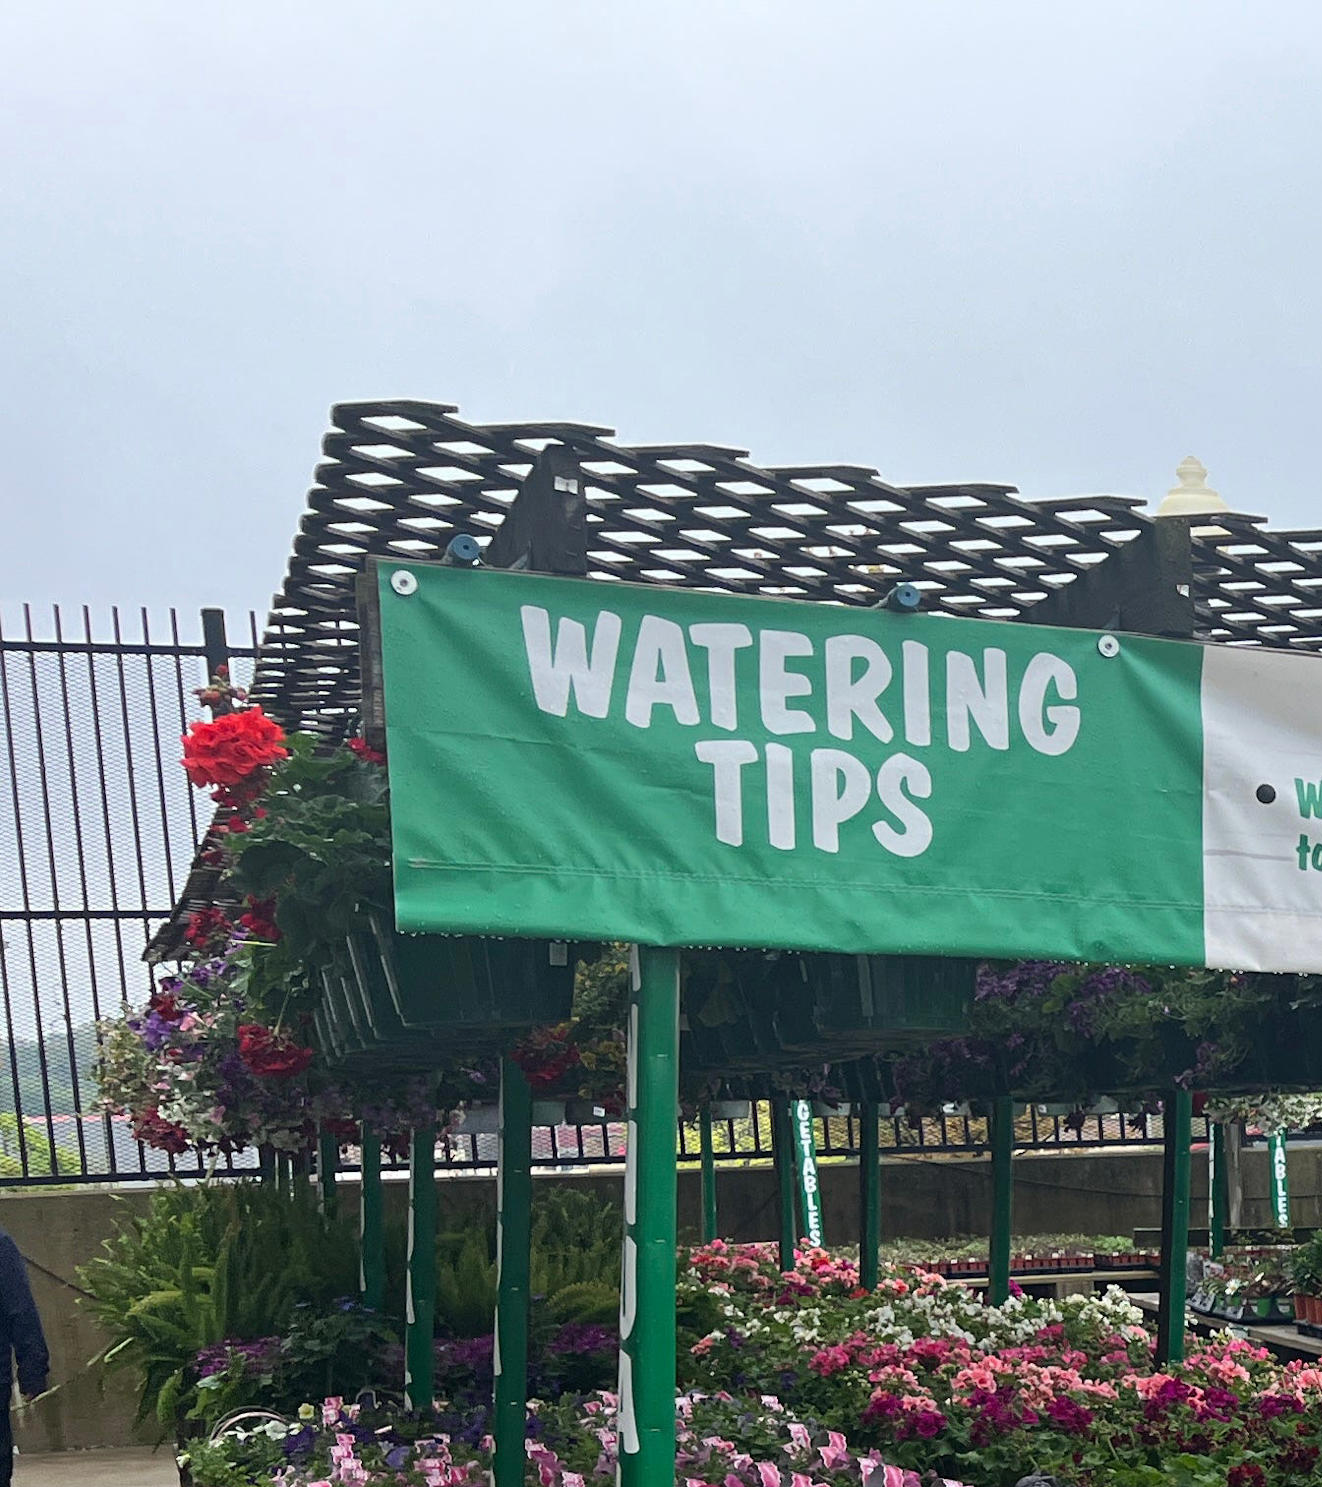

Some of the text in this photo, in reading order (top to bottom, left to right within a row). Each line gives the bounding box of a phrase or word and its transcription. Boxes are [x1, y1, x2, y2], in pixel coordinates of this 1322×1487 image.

[520, 604, 1081, 756] WATERING
[695, 739, 934, 858] TIPS
[797, 1100, 821, 1247] GETABLES
